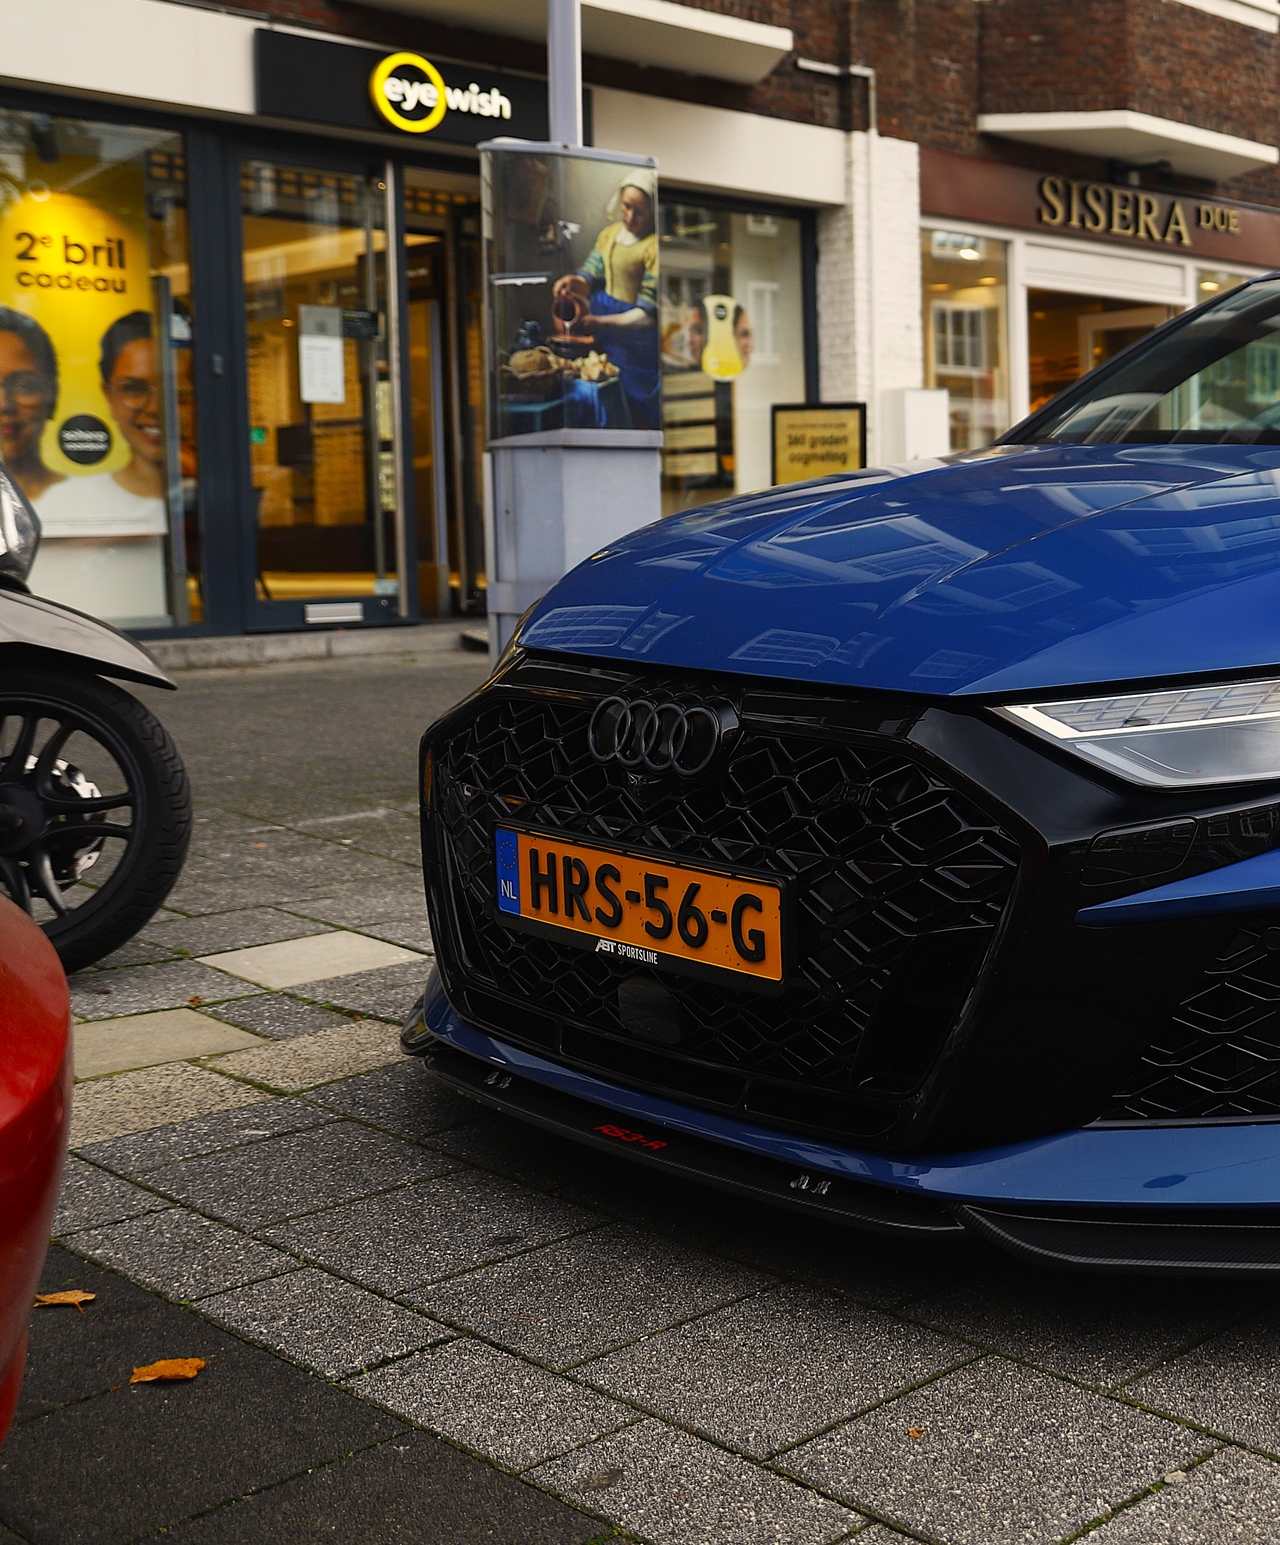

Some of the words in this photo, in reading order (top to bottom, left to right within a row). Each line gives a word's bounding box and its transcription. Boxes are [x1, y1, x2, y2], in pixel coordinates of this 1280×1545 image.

[1041, 176, 1193, 246] SISERA
[1199, 204, 1241, 235] DUE
[62, 235, 126, 269] bril
[16, 270, 127, 294] cadeau
[500, 878, 518, 900] NL
[529, 848, 766, 963] HRS-56-G
[595, 938, 617, 953] ABT
[617, 943, 659, 965] SPORTSLINE
[593, 1123, 669, 1150] RS3-R
